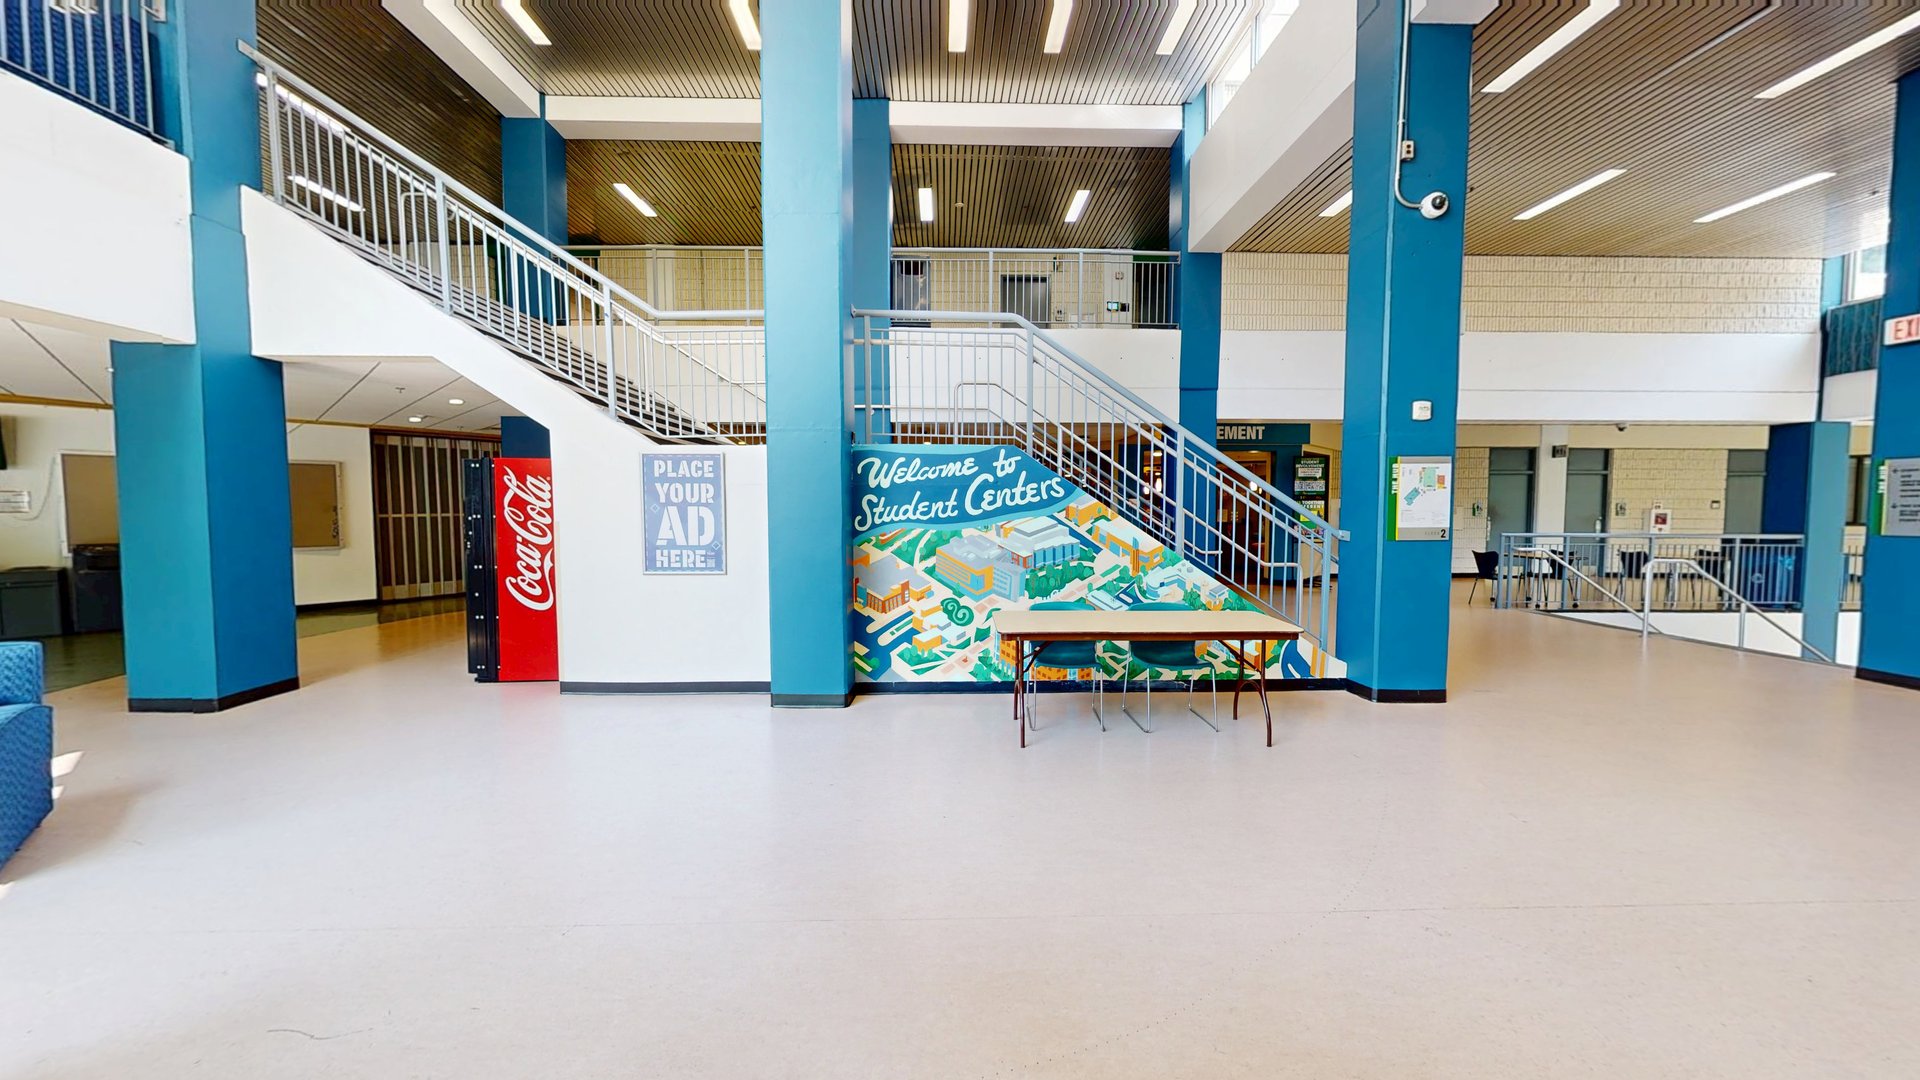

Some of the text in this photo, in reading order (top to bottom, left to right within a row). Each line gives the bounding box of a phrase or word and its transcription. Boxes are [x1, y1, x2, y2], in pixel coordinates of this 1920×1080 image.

[1216, 425, 1265, 440] EMENT
[653, 459, 715, 478] PLACE
[856, 448, 1022, 489] Welcome to
[654, 482, 715, 504] YOUR
[854, 470, 1065, 532] Student Centers
[655, 505, 715, 546] AD
[1440, 528, 1447, 538] 2
[655, 549, 706, 568] HERE
